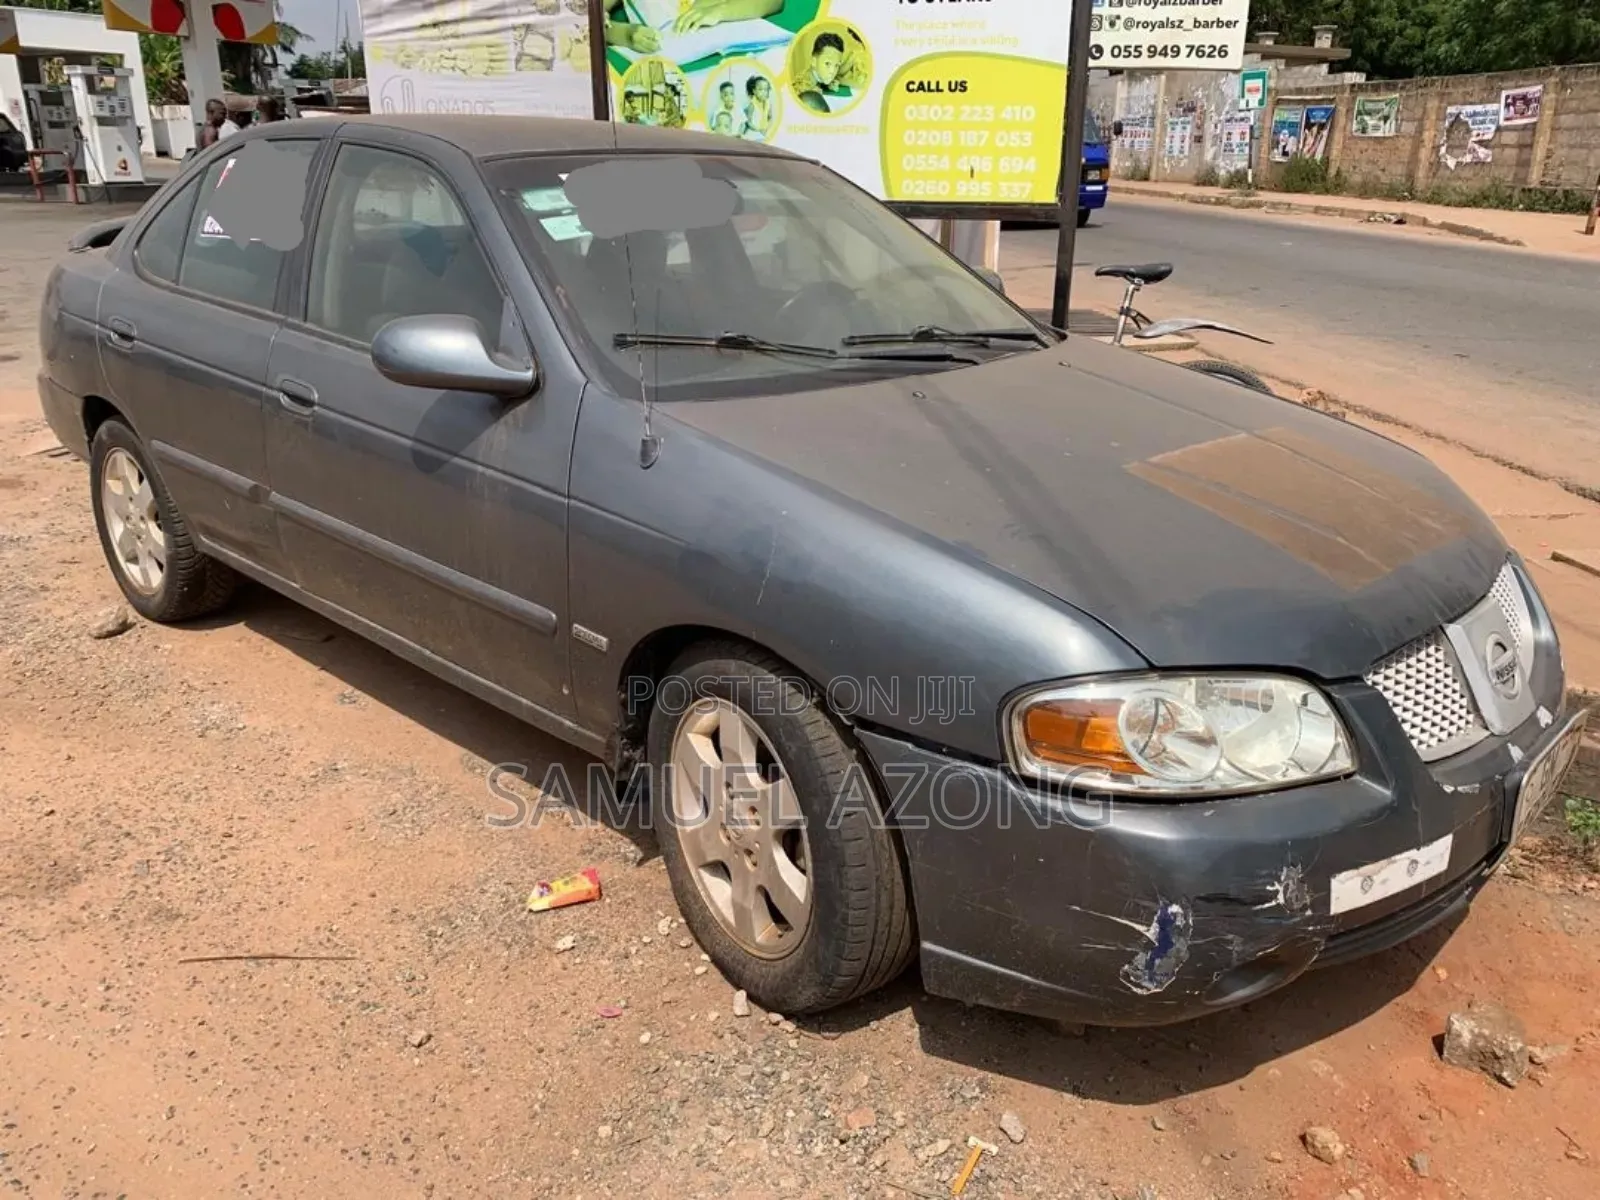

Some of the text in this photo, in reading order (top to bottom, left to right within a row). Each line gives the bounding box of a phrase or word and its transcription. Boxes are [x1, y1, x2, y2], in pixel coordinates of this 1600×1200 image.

[1123, 17, 1239, 32] @royalsz_barber
[1110, 45, 1229, 59] 055 949 7626
[905, 81, 968, 93] CALL US
[904, 104, 1036, 122] 0302 223 410
[903, 129, 952, 147] 0208
[995, 130, 1033, 148] 053
[902, 154, 950, 172] 0554
